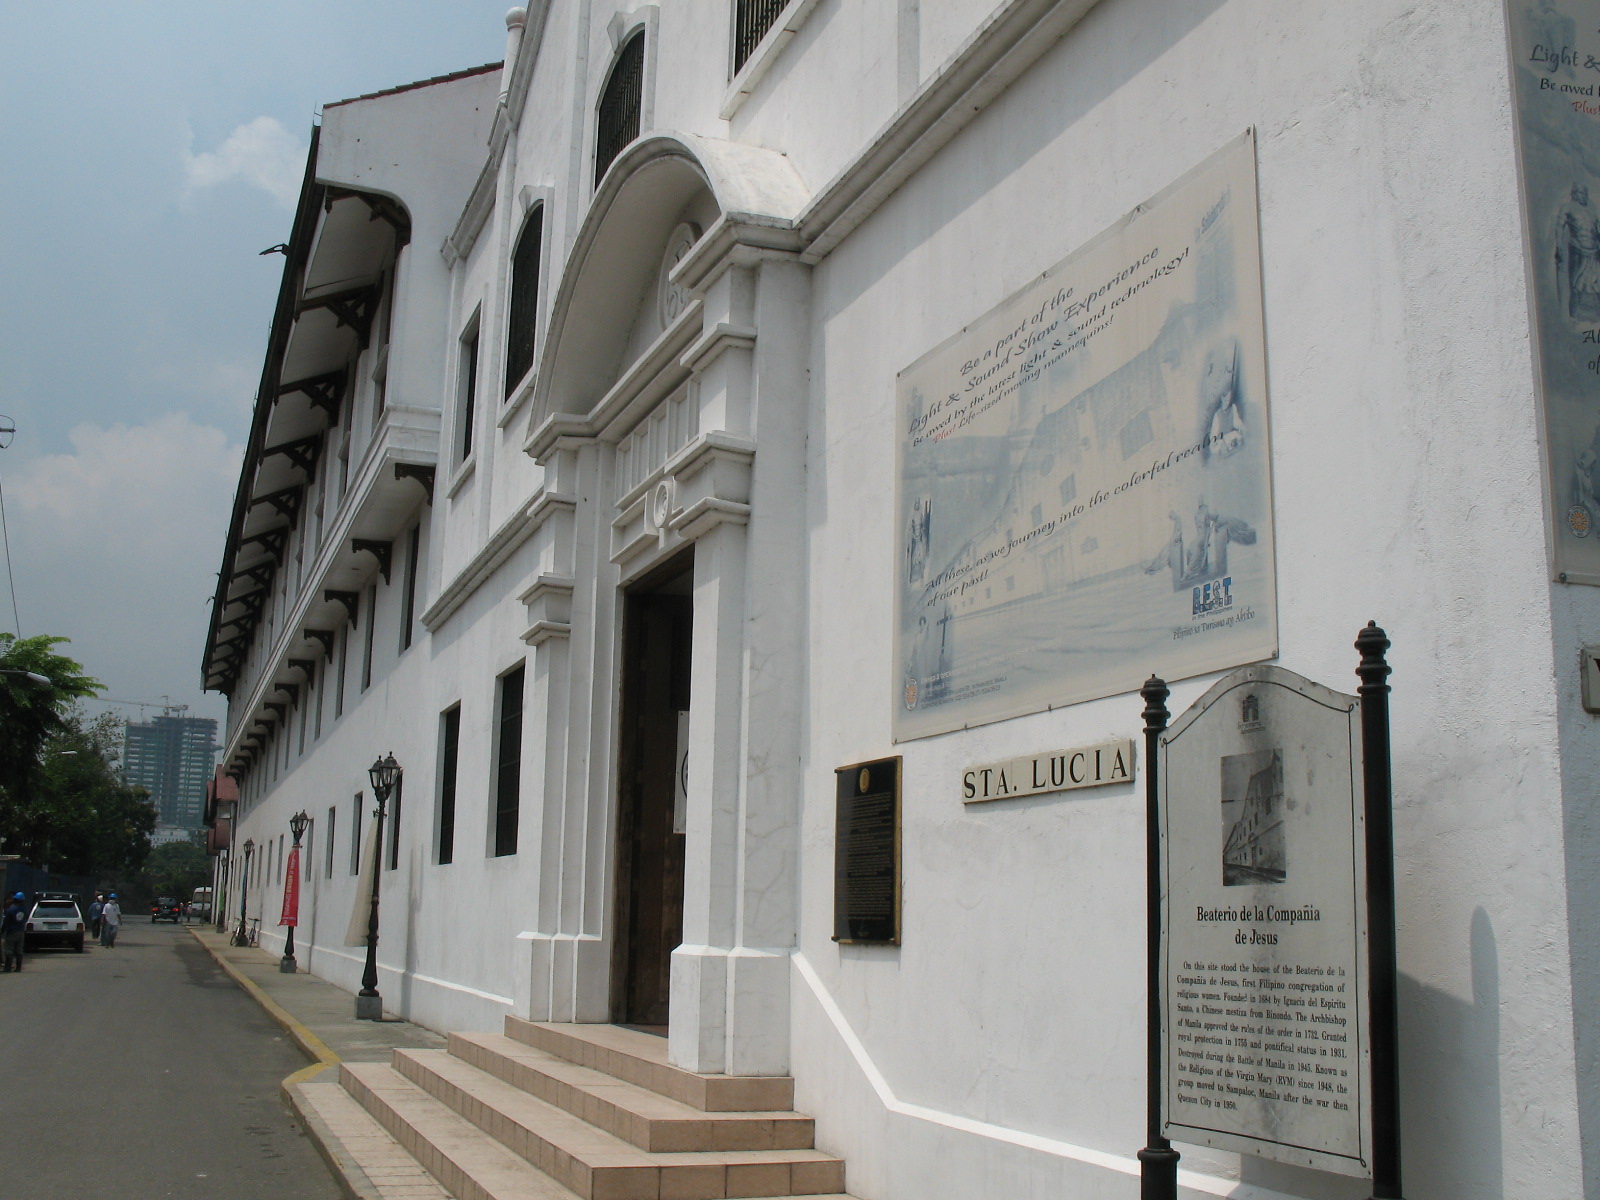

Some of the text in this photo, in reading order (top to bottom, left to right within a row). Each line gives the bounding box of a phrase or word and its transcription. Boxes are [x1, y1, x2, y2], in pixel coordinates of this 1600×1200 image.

[1529, 44, 1579, 72] Light
[1540, 78, 1556, 90] Be
[1560, 84, 1593, 96] awed
[908, 247, 1159, 434] Light & Sound Show Experience
[960, 287, 1074, 376] Be a part of the
[912, 246, 1190, 447] Be awed by the latest light & sound technology!
[932, 313, 1115, 444] Plus! Life-sized moving mannequins!
[925, 431, 1224, 592] All these, as we journey into the colorful realm
[927, 568, 989, 607] of our past!
[963, 747, 1128, 798] STA. LUCIA
[1197, 904, 1320, 925] Beaterio de la Compañia
[1235, 928, 1278, 945] de Jesus
[1183, 961, 1345, 976] On this site stood the house of the Beaterio de la
[1209, 976, 1217, 985] de
[1220, 977, 1239, 987] Jesus,
[1242, 978, 1256, 988] first
[1259, 979, 1285, 990] Filipino
[1288, 982, 1334, 993] congregation
[1337, 983, 1346, 992] of
[1177, 989, 1199, 999] religious
[1223, 992, 1248, 1002] Founded
[1250, 994, 1256, 1002] in
[1273, 995, 1280, 1006] by
[1283, 995, 1305, 1007] Ignacia
[1308, 997, 1318, 1007] del
[1320, 997, 1346, 1010] Espiritu
[1202, 1004, 1223, 1014] Chinese
[1226, 1008, 1247, 1017] mestiza
[1249, 1008, 1263, 1018] from
[1295, 1011, 1307, 1022] The
[1310, 1013, 1347, 1027] Archbishop
[1177, 1018, 1183, 1026] of
[1184, 1018, 1202, 1028] Manila
[1204, 1022, 1228, 1031] approved
[1230, 1023, 1239, 1032] the
[1241, 1024, 1255, 1033] rules
[1257, 1025, 1263, 1034] of
[1265, 1025, 1274, 1035] the
[1276, 1027, 1293, 1037] order
[1295, 1028, 1302, 1038] in
[1321, 1030, 1347, 1042] Granted
[1178, 1033, 1192, 1042] royal
[1194, 1035, 1223, 1045] protection
[1225, 1037, 1232, 1045] in
[1250, 1040, 1261, 1049] and
[1264, 1041, 1294, 1053] pontifical
[1297, 1045, 1316, 1055] status
[1319, 1046, 1327, 1056] in
[1330, 1047, 1347, 1058] 1931.
[1178, 1048, 1204, 1060] Destroyed
[1205, 1051, 1223, 1063] during
[1226, 1053, 1235, 1063] the
[1237, 1055, 1255, 1065] Battle
[1257, 1057, 1263, 1066] of
[1265, 1058, 1285, 1069] Manila
[1288, 1061, 1294, 1070] in
[1315, 1063, 1337, 1076] Known
[1340, 1069, 1348, 1077] as
[1178, 1063, 1186, 1071] the
[1189, 1063, 1214, 1076] Religious
[1216, 1068, 1222, 1076] of
[1224, 1068, 1233, 1078] the
[1236, 1069, 1255, 1082] Virgin
[1257, 1072, 1272, 1085] Mary
[1298, 1078, 1314, 1089] since
[1336, 1083, 1348, 1094] the
[1177, 1093, 1198, 1104] Quezon
[1200, 1095, 1212, 1108] City
[1214, 1098, 1220, 1107] in
[1178, 1079, 1348, 1111] group moved to Sampaloc, Manila after the war then
